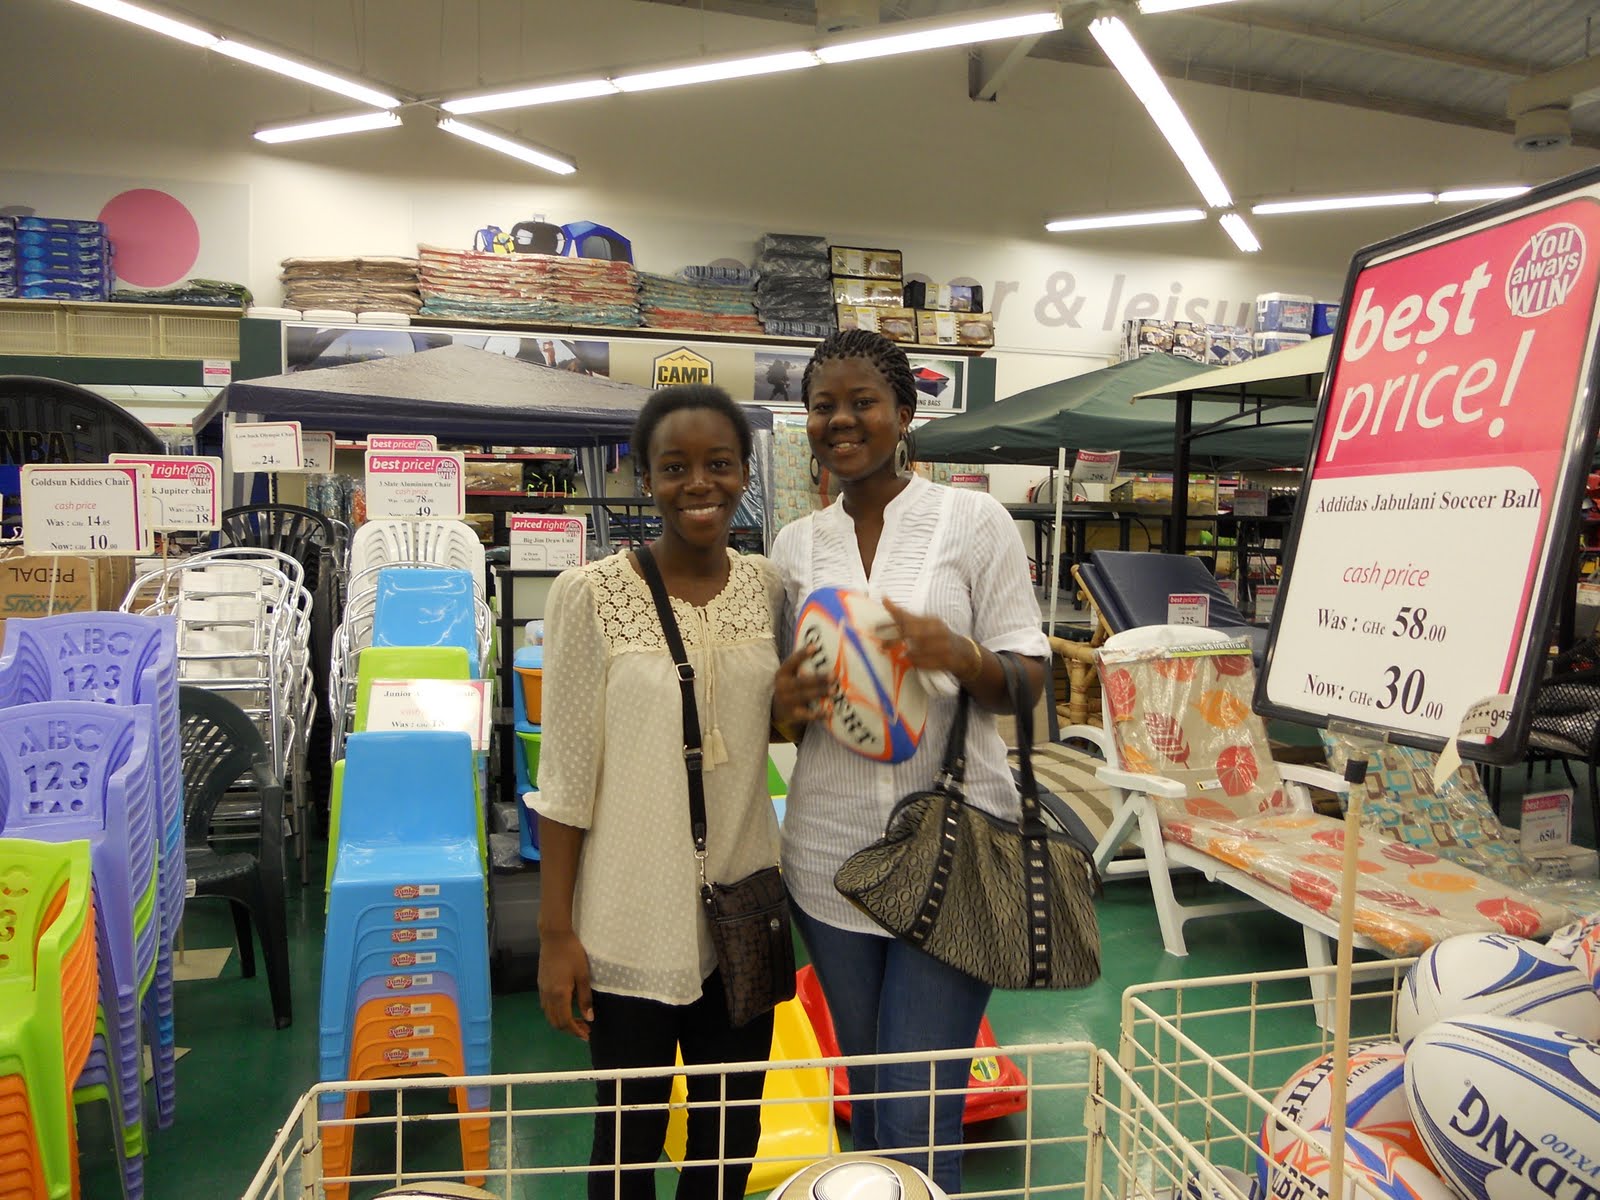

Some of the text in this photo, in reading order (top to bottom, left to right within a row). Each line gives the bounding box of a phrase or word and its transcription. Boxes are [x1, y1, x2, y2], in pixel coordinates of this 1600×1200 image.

[1512, 252, 1579, 285] always
[1512, 274, 1570, 316] WIN
[1344, 261, 1492, 362] best
[658, 366, 708, 384] CAMP
[1326, 329, 1536, 462] price!
[393, 440, 415, 449] price!
[157, 464, 189, 477] right!
[262, 456, 274, 464] 24
[304, 459, 314, 467] 25
[372, 458, 435, 472] best price!
[160, 488, 189, 496] Jupiter
[1316, 488, 1540, 513] Addidas Jabulani Soccer Ball
[76, 502, 96, 511] price
[196, 514, 208, 523] 18
[514, 520, 565, 531] priced right!
[8, 568, 74, 582] PEDAL
[1343, 561, 1429, 590] cash price
[1317, 608, 1347, 630] Was
[1392, 606, 1447, 642] 58.00
[59, 628, 133, 660] ABC
[1304, 674, 1344, 700] Now:
[1376, 666, 1443, 720] 30.00
[19, 720, 103, 757] ABC
[1449, 1085, 1600, 1200] LDING
